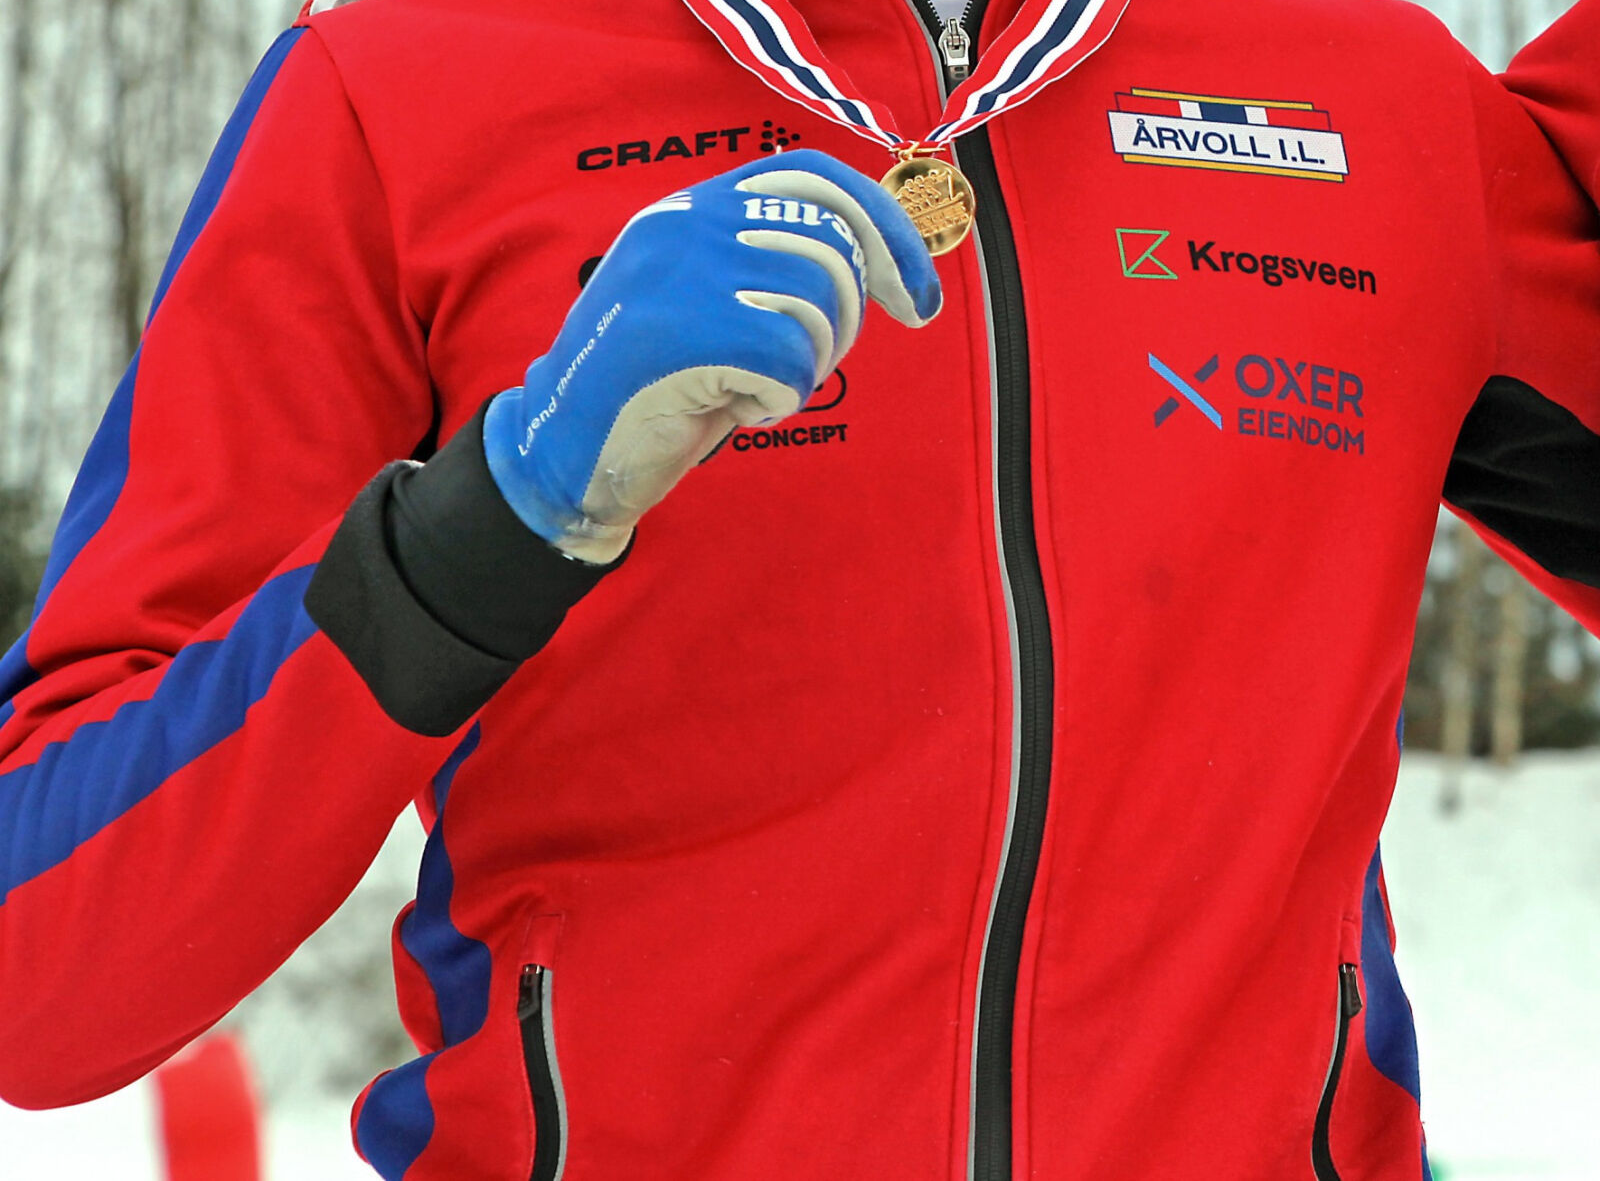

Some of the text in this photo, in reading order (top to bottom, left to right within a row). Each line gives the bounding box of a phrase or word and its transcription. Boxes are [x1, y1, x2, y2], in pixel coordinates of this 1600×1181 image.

[576, 127, 750, 171] CRAFT
[1132, 119, 1326, 165] ÅRVOLL I.L.
[1187, 240, 1377, 295] Krogsveen
[556, 338, 596, 396] Thermo
[596, 302, 622, 337] Slim
[1234, 354, 1365, 418] OXER
[732, 424, 848, 452] CONCEPT
[1237, 407, 1366, 456] EIENDOM
